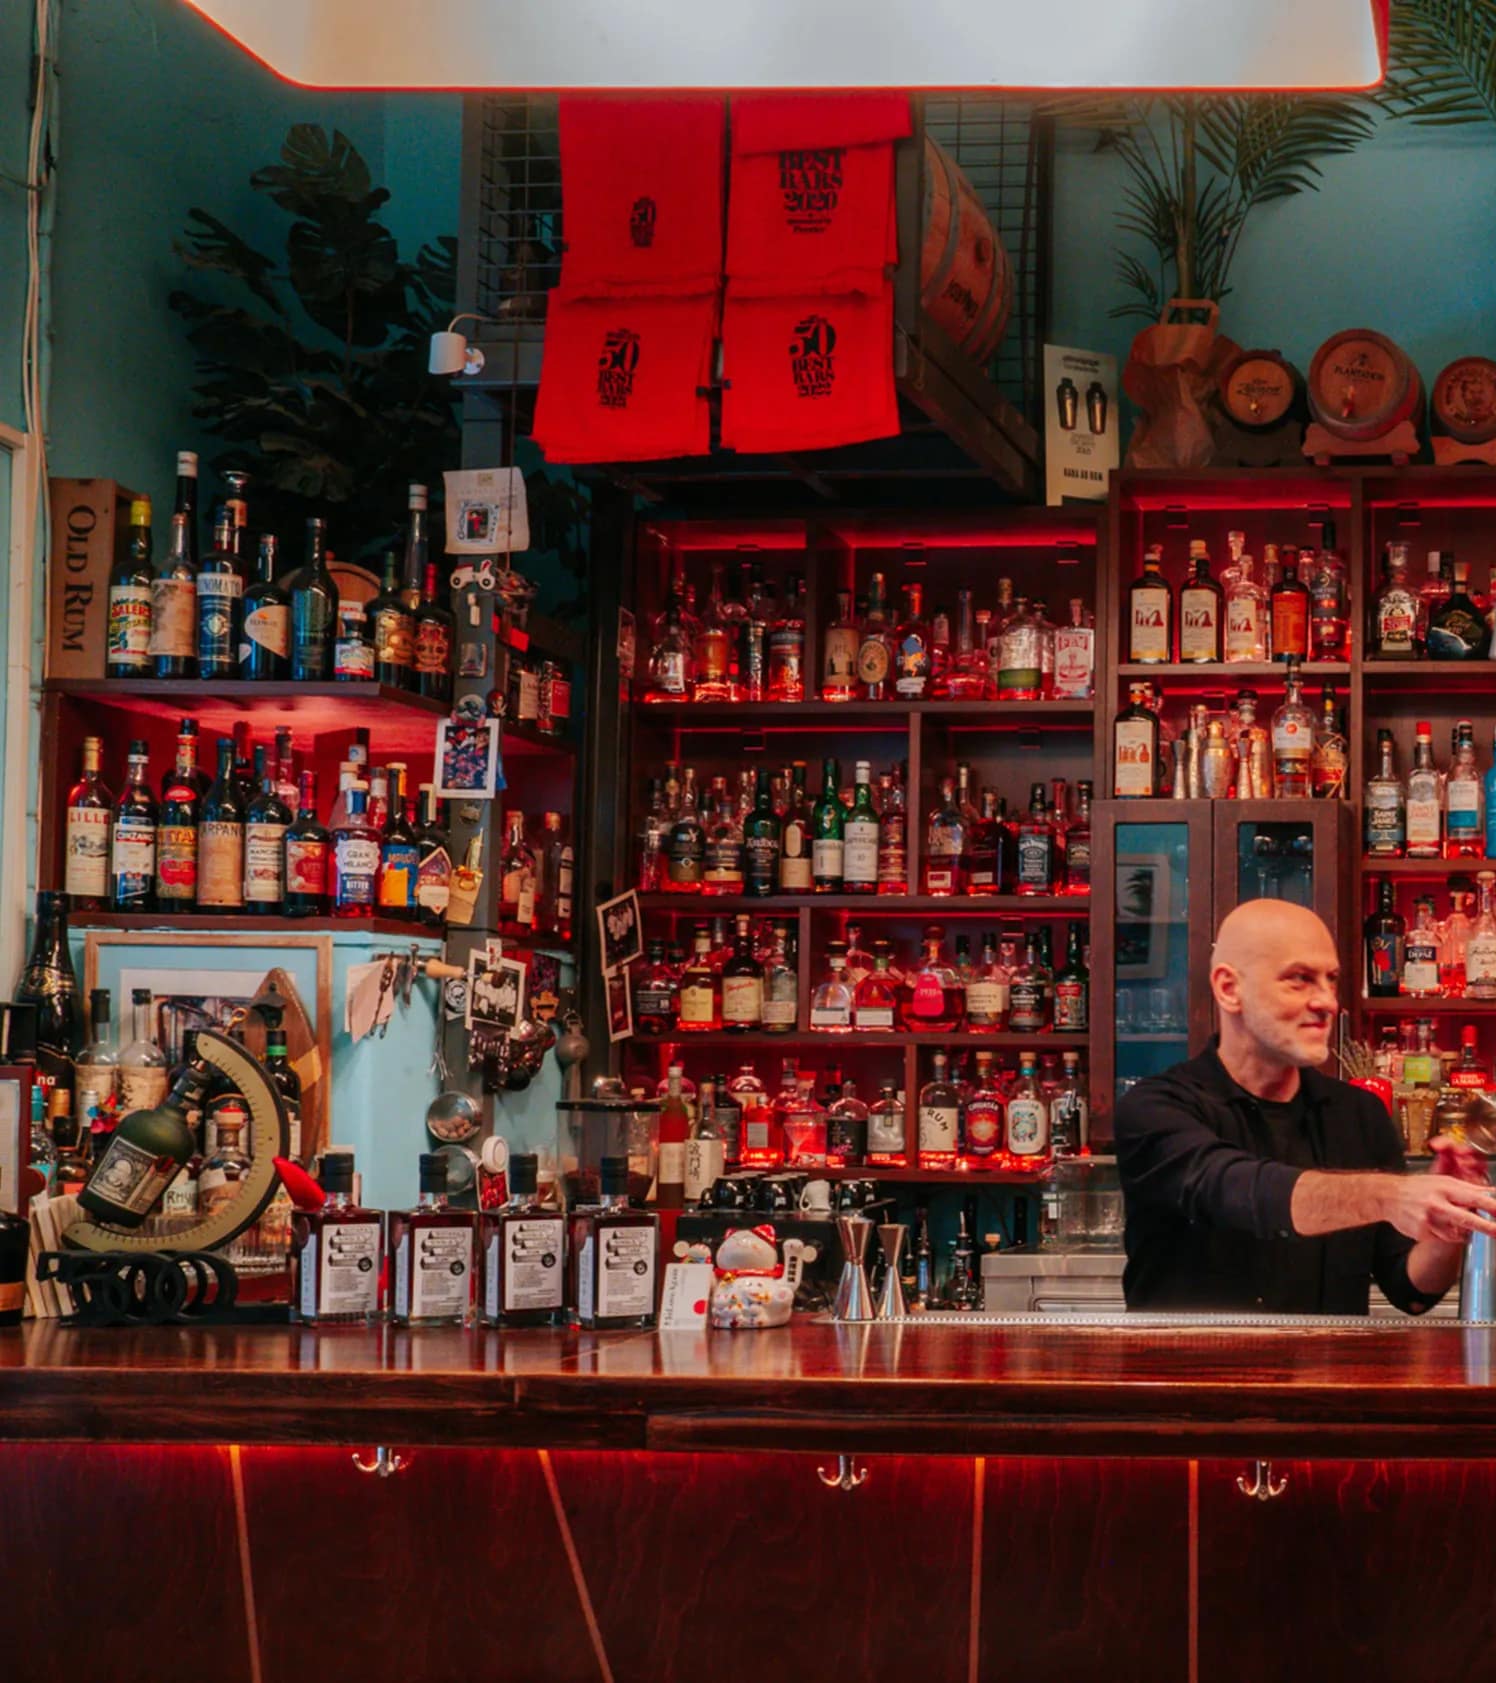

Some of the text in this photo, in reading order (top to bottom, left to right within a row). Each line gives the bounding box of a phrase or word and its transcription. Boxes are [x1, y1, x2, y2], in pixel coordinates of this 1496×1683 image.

[779, 171, 842, 189] BARS
[789, 324, 837, 356] 50
[599, 341, 640, 370] 50
[793, 356, 835, 371] BEST
[793, 370, 835, 385] BARS
[62, 505, 97, 653] OLD RUM
[926, 1108, 949, 1132] RUM
